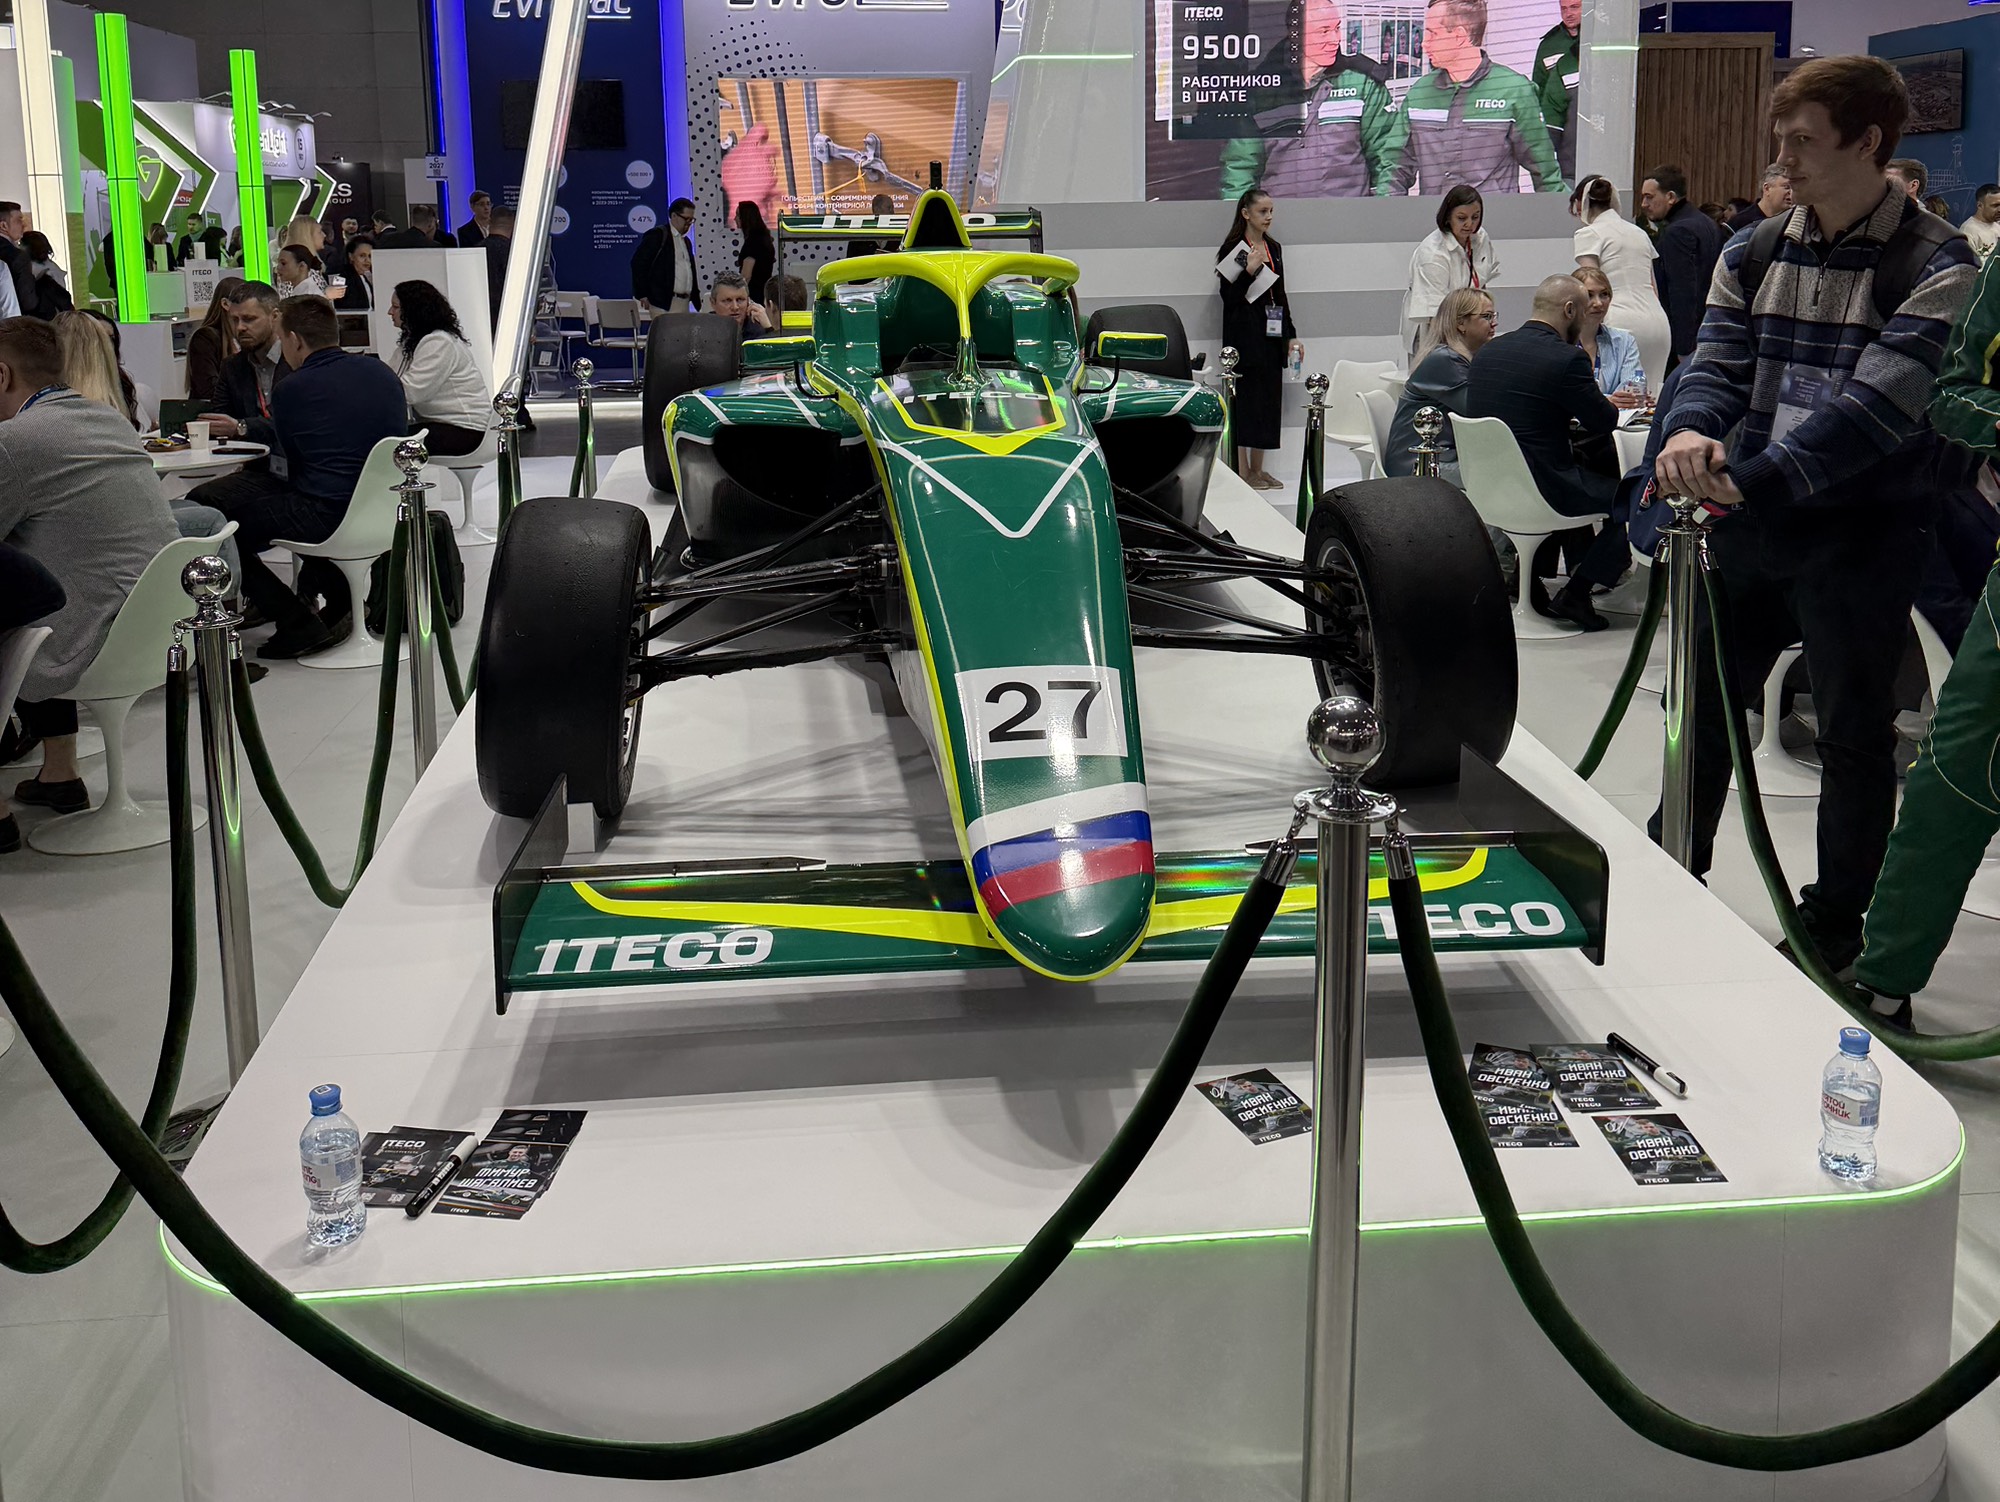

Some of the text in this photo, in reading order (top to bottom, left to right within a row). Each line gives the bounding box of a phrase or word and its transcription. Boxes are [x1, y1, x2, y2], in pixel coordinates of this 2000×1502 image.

[1184, 6, 1224, 18] ITECO
[1182, 34, 1261, 60] 9500
[1182, 74, 1281, 88] РАБОТНИКОВ
[1182, 90, 1247, 103] В ШТАТЕ
[1329, 88, 1357, 98] ITECO
[1475, 99, 1506, 109] ITECO
[821, 213, 997, 229] ITEO
[984, 680, 1103, 744] 27
[1369, 901, 1567, 941] TECO
[534, 928, 775, 976] ITECO
[1494, 1067, 1533, 1079] ИВАН
[1568, 1061, 1603, 1072] ИВАН
[1477, 1073, 1551, 1090] ОВСИЕНКО
[1559, 1069, 1627, 1082] ОВСИЕНКО
[1240, 1092, 1274, 1109] ИВАН
[1237, 1095, 1299, 1123] ОВСИЕНКО
[1488, 1112, 1559, 1126] ОВСИЕНКО
[381, 1139, 426, 1148] ITECO
[1259, 1132, 1282, 1143] ITECO
[1636, 1136, 1674, 1149] ИВАН
[1628, 1144, 1700, 1161] ОВСИЕНКО
[457, 1178, 538, 1189] ШАГАЛИЕВ
